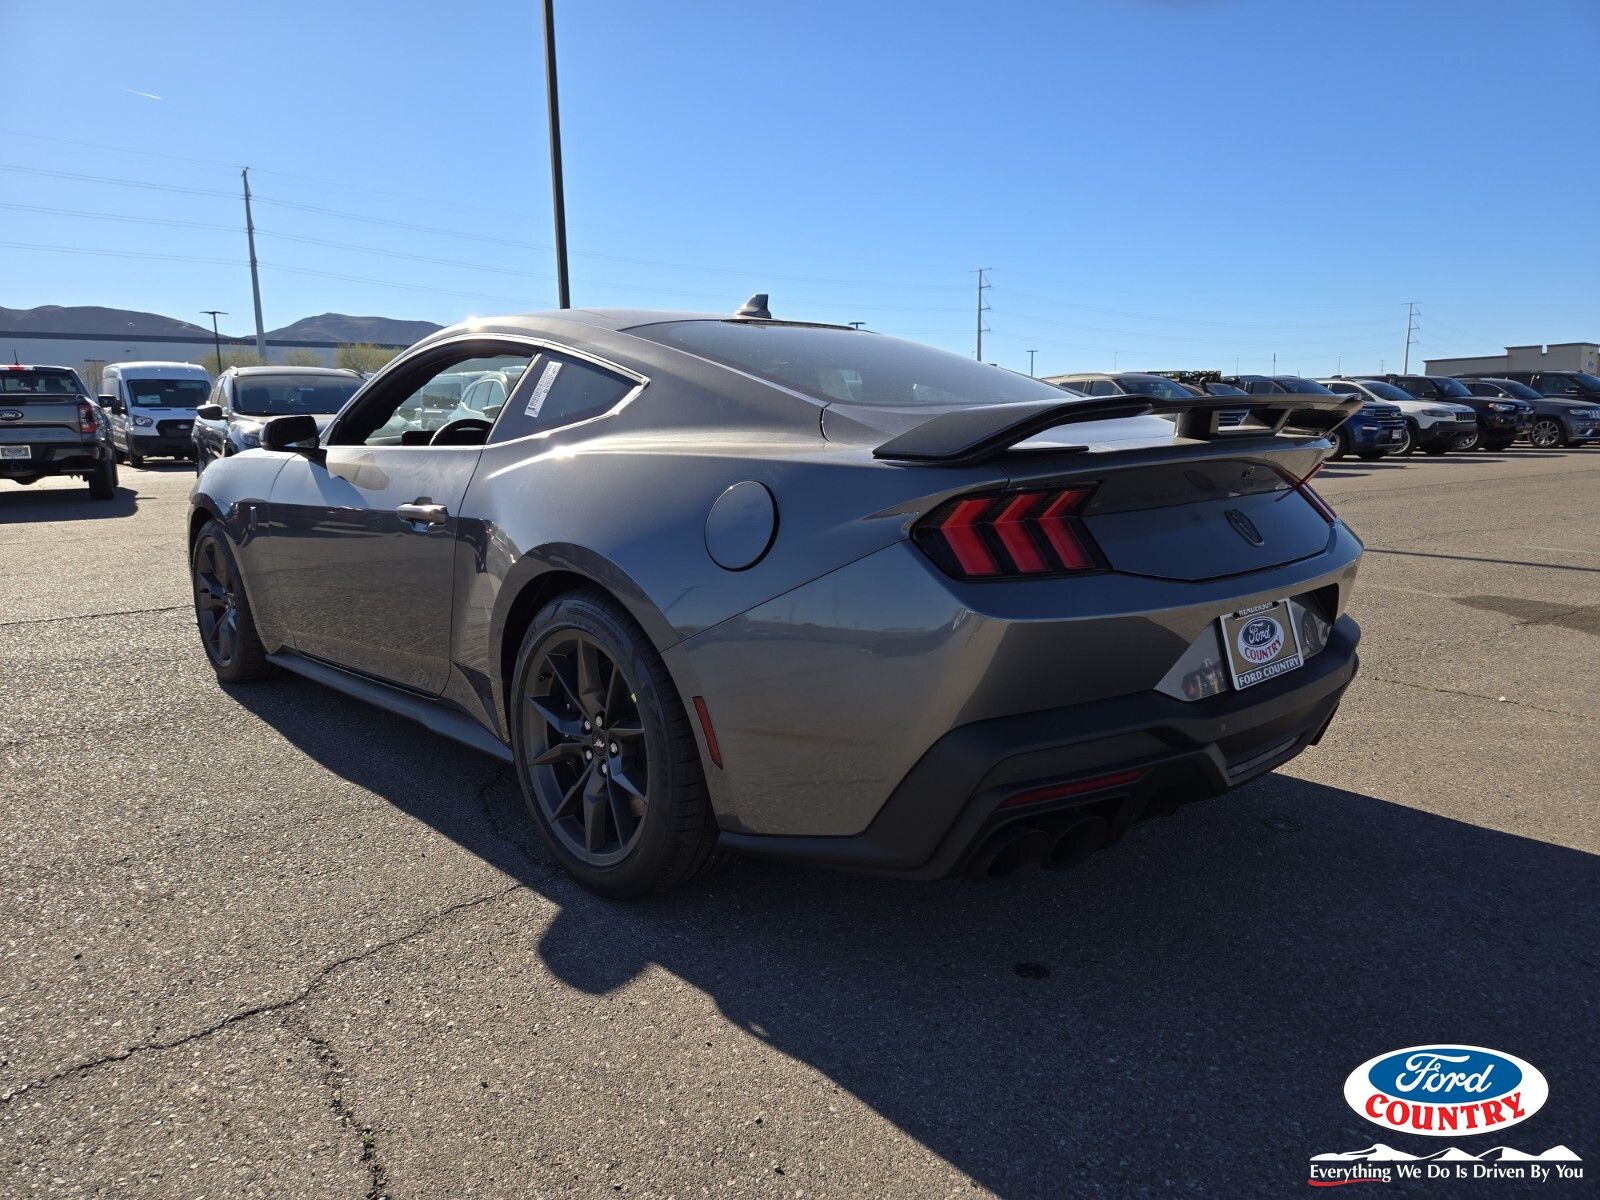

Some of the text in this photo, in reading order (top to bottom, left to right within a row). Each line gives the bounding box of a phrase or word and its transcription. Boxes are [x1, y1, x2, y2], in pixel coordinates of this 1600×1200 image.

[1248, 622, 1271, 643] Ford
[1244, 638, 1281, 660] COUNTRY
[1239, 656, 1301, 687] FORD COUNTRY
